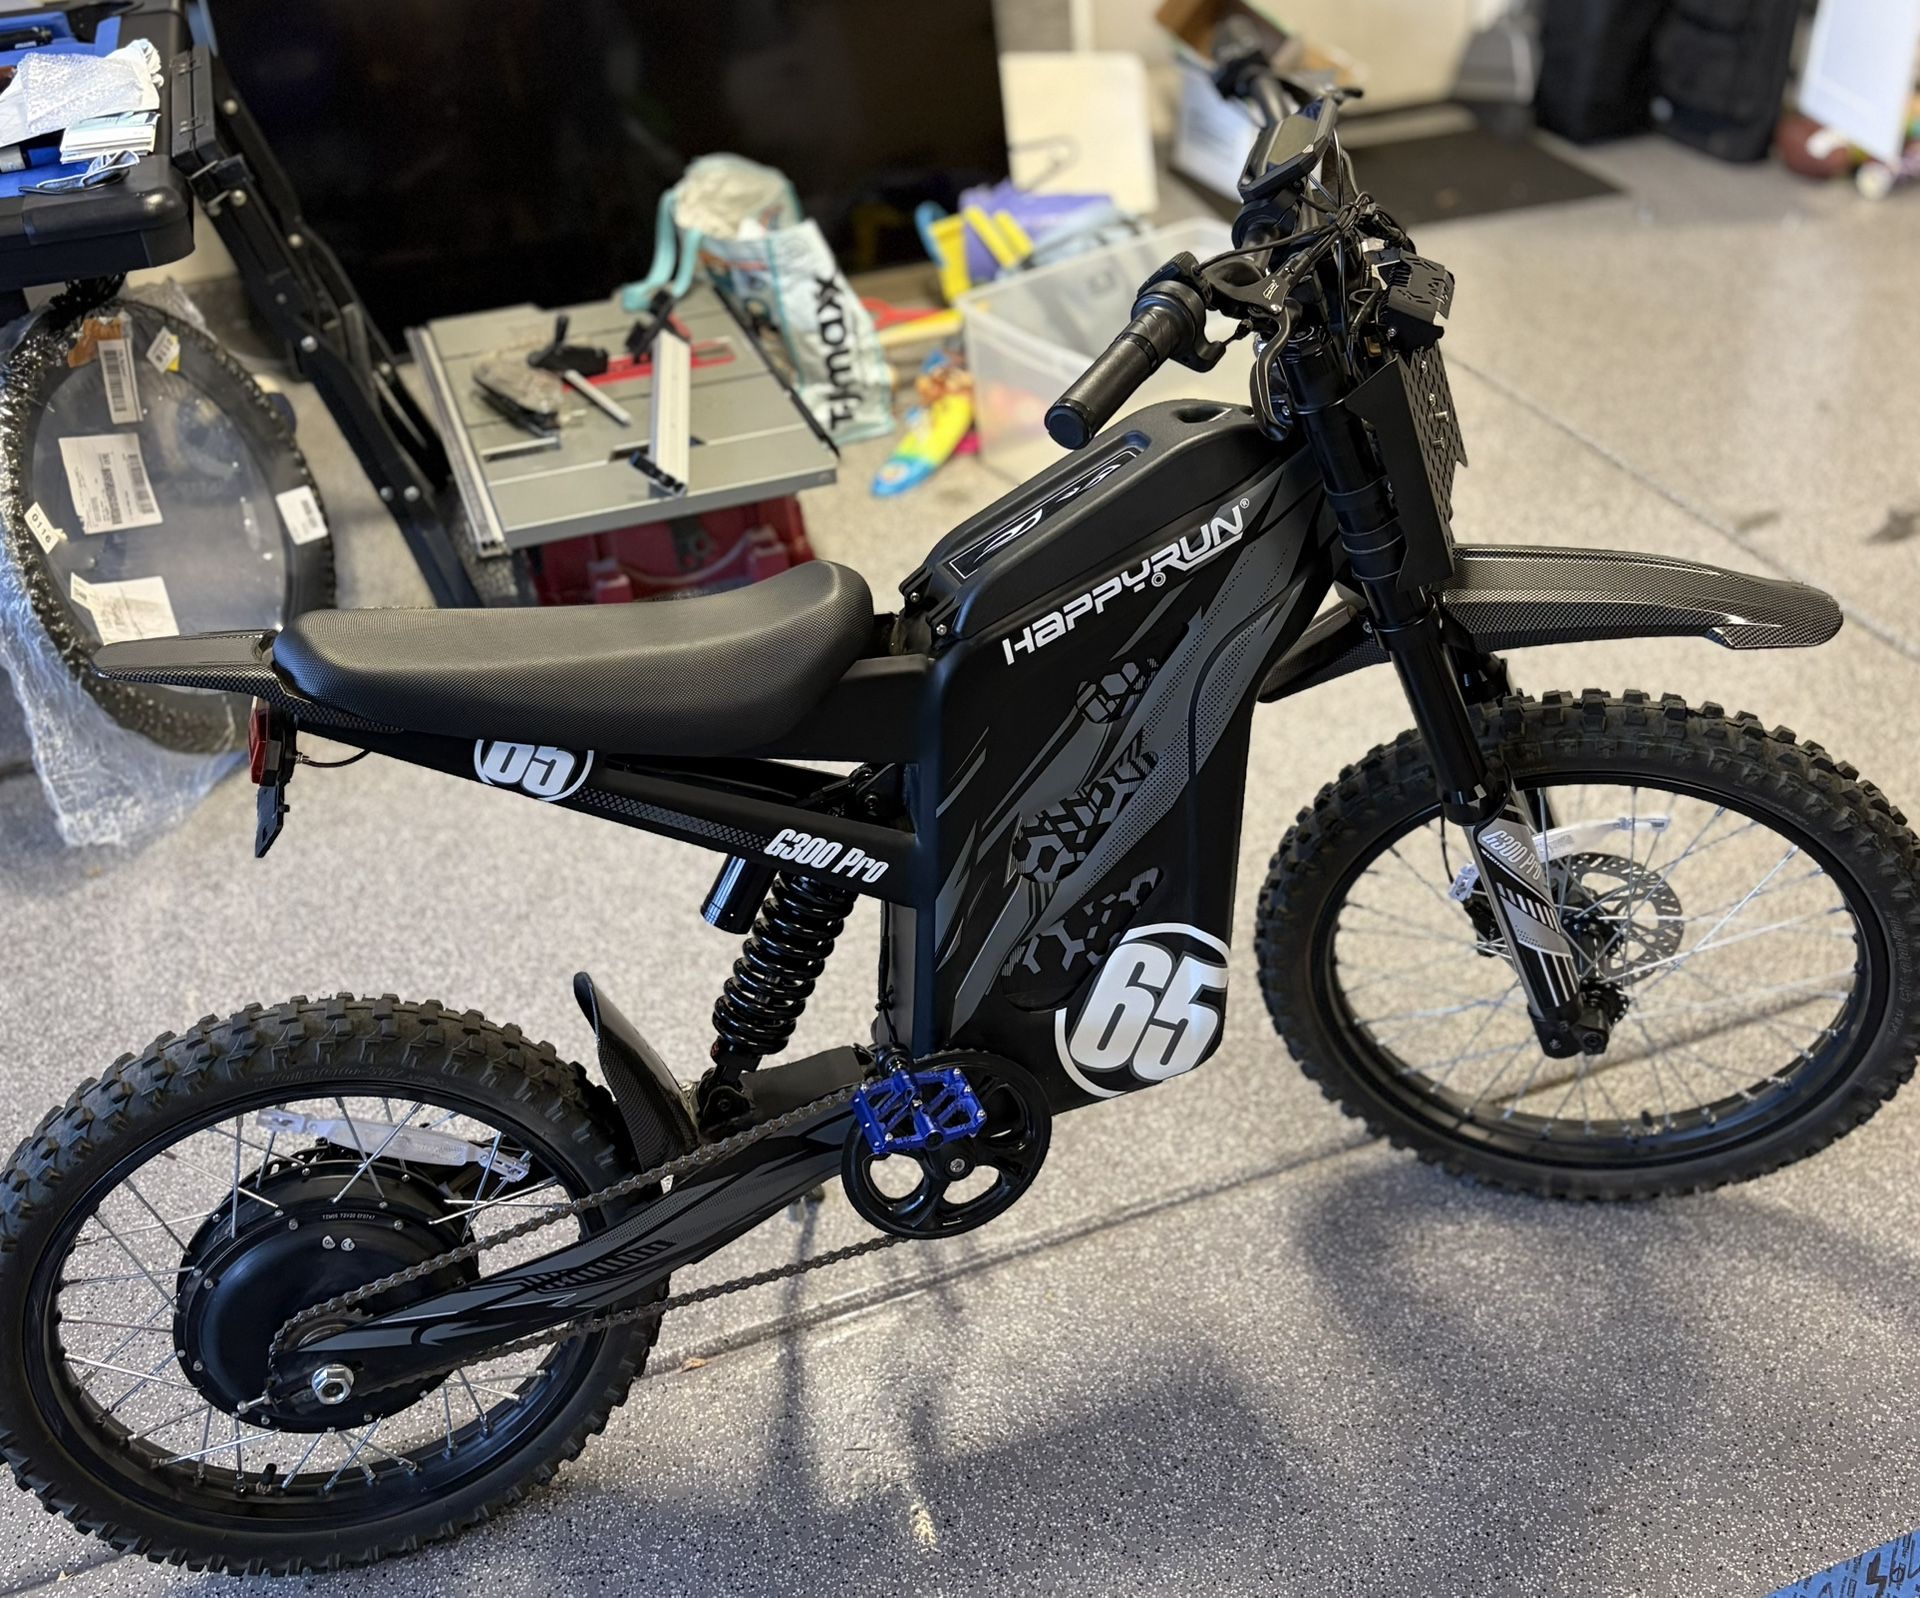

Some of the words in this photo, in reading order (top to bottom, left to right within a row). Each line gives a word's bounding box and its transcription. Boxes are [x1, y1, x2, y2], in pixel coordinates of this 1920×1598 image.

[764, 829, 843, 868] G300
[831, 848, 889, 883] Pro
[1481, 830, 1528, 863] G300
[1070, 943, 1228, 1081] 65
